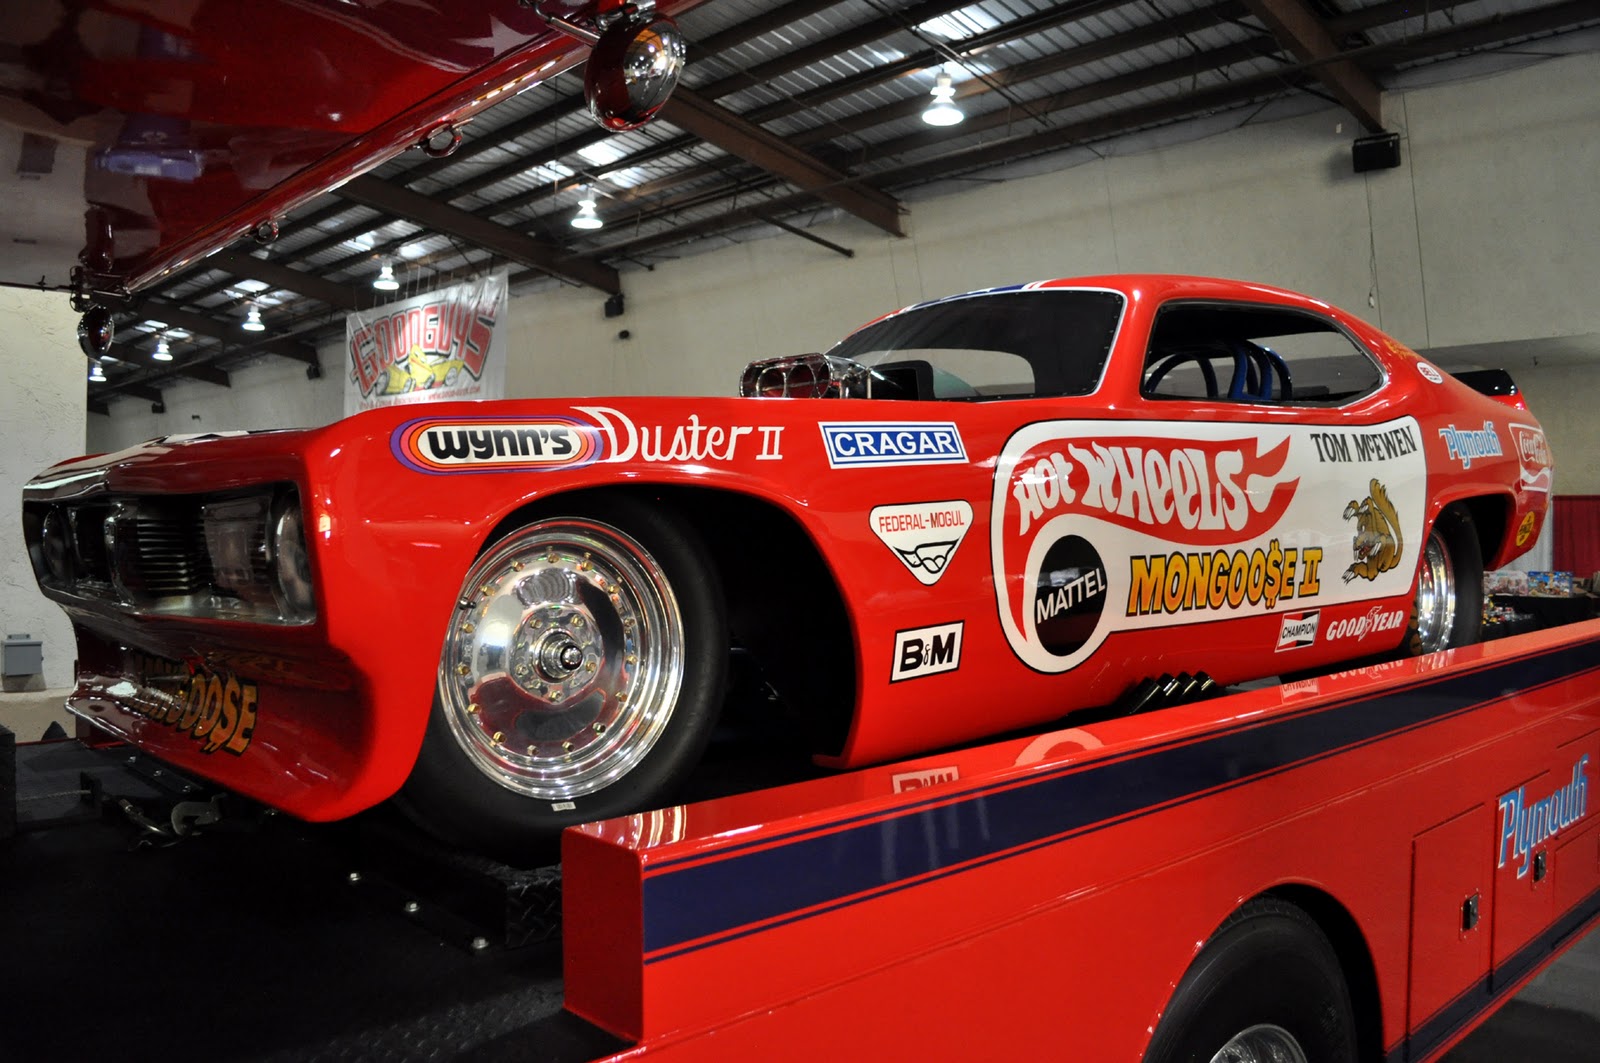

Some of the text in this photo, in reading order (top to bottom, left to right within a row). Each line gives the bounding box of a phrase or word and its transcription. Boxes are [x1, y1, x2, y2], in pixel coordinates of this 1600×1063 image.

[350, 299, 496, 399] GOODGUYS
[570, 406, 785, 464] Duster II
[834, 432, 956, 457] CRAGAR
[1310, 432, 1350, 463] TOM
[1439, 420, 1503, 469] Plymouth
[878, 509, 965, 533] FEDERAL-MOGUL
[1036, 568, 1106, 625] MATTEL
[1298, 547, 1322, 597] II
[899, 632, 955, 673] B&M
[1282, 622, 1315, 639] CHAMPION
[1497, 753, 1589, 880] Plymouth
